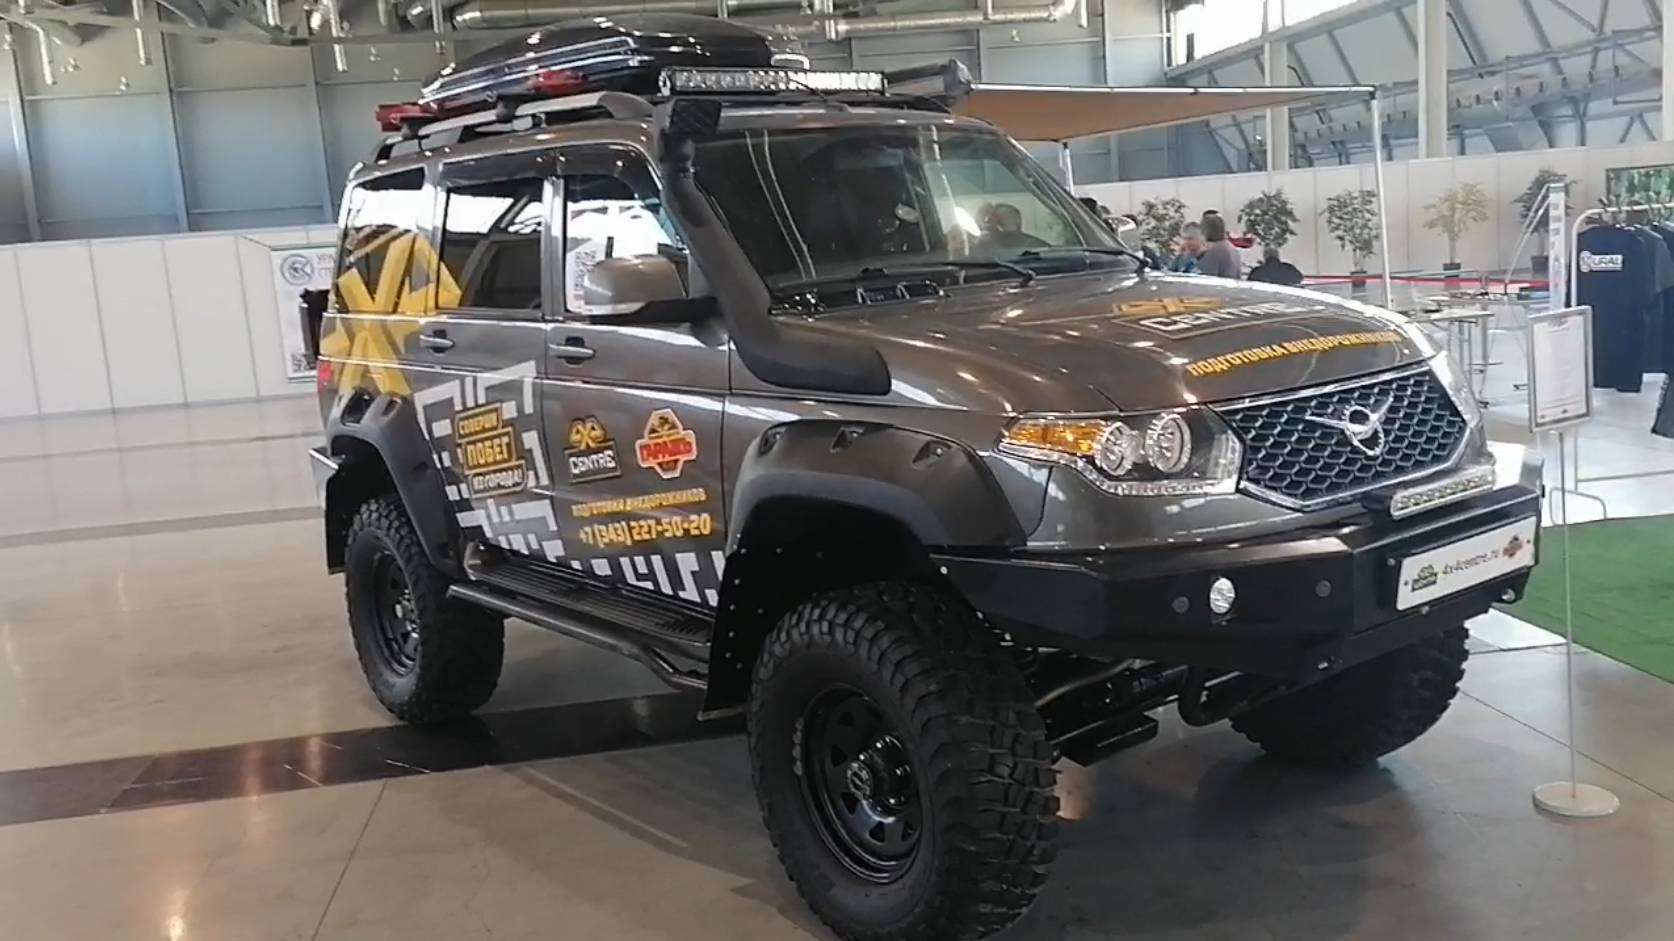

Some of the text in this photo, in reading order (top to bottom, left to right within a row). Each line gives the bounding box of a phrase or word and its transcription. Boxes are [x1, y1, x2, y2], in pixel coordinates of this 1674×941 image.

[1185, 342, 1288, 377] ПОДГОТОВКА
[466, 435, 510, 467] ПОБЕГ
[569, 449, 617, 474] CENTRE
[579, 512, 712, 549] +7 (343) 227-50-20
